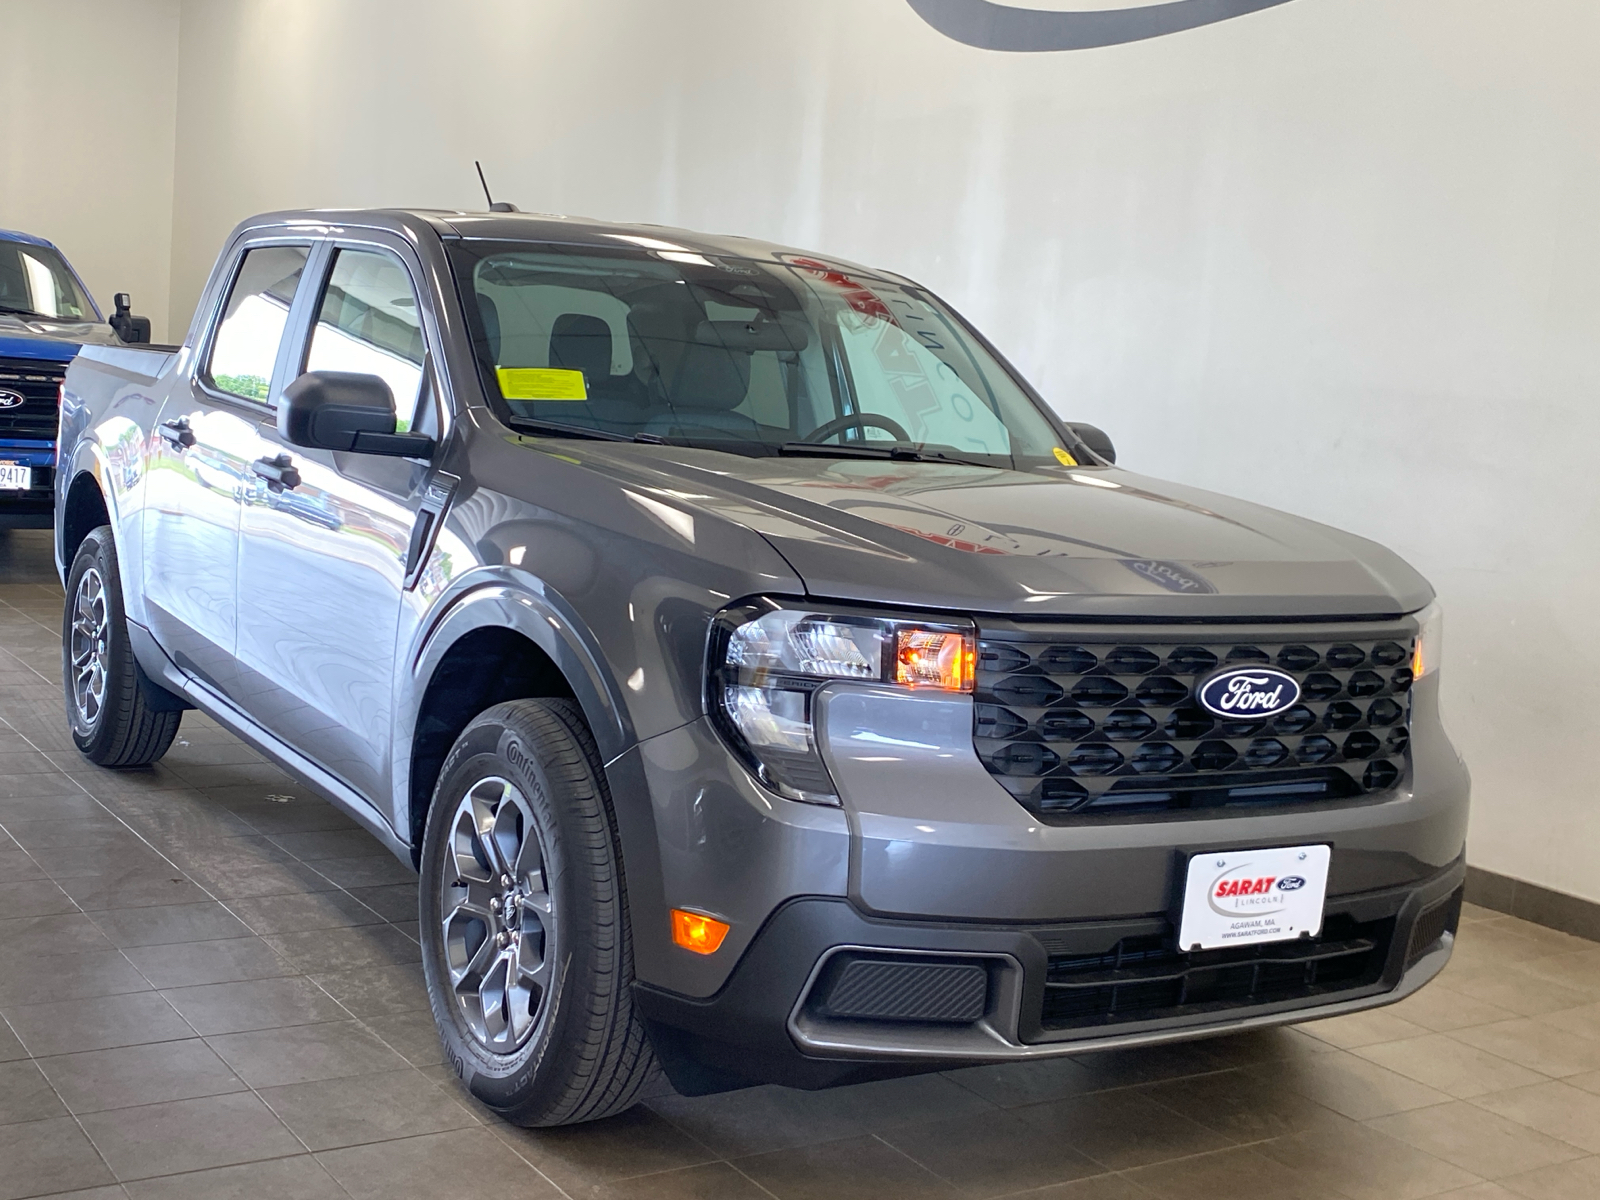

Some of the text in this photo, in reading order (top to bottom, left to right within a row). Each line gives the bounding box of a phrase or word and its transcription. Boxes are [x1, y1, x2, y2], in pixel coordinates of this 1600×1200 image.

[1220, 676, 1283, 710] Ford
[507, 740, 557, 831] Continental
[1215, 876, 1276, 898] SARAT
[1241, 896, 1278, 906] LINCOLN
[1222, 927, 1281, 938] WWW.SARATFORD.COM
[1230, 920, 1262, 929] AGAWAM,
